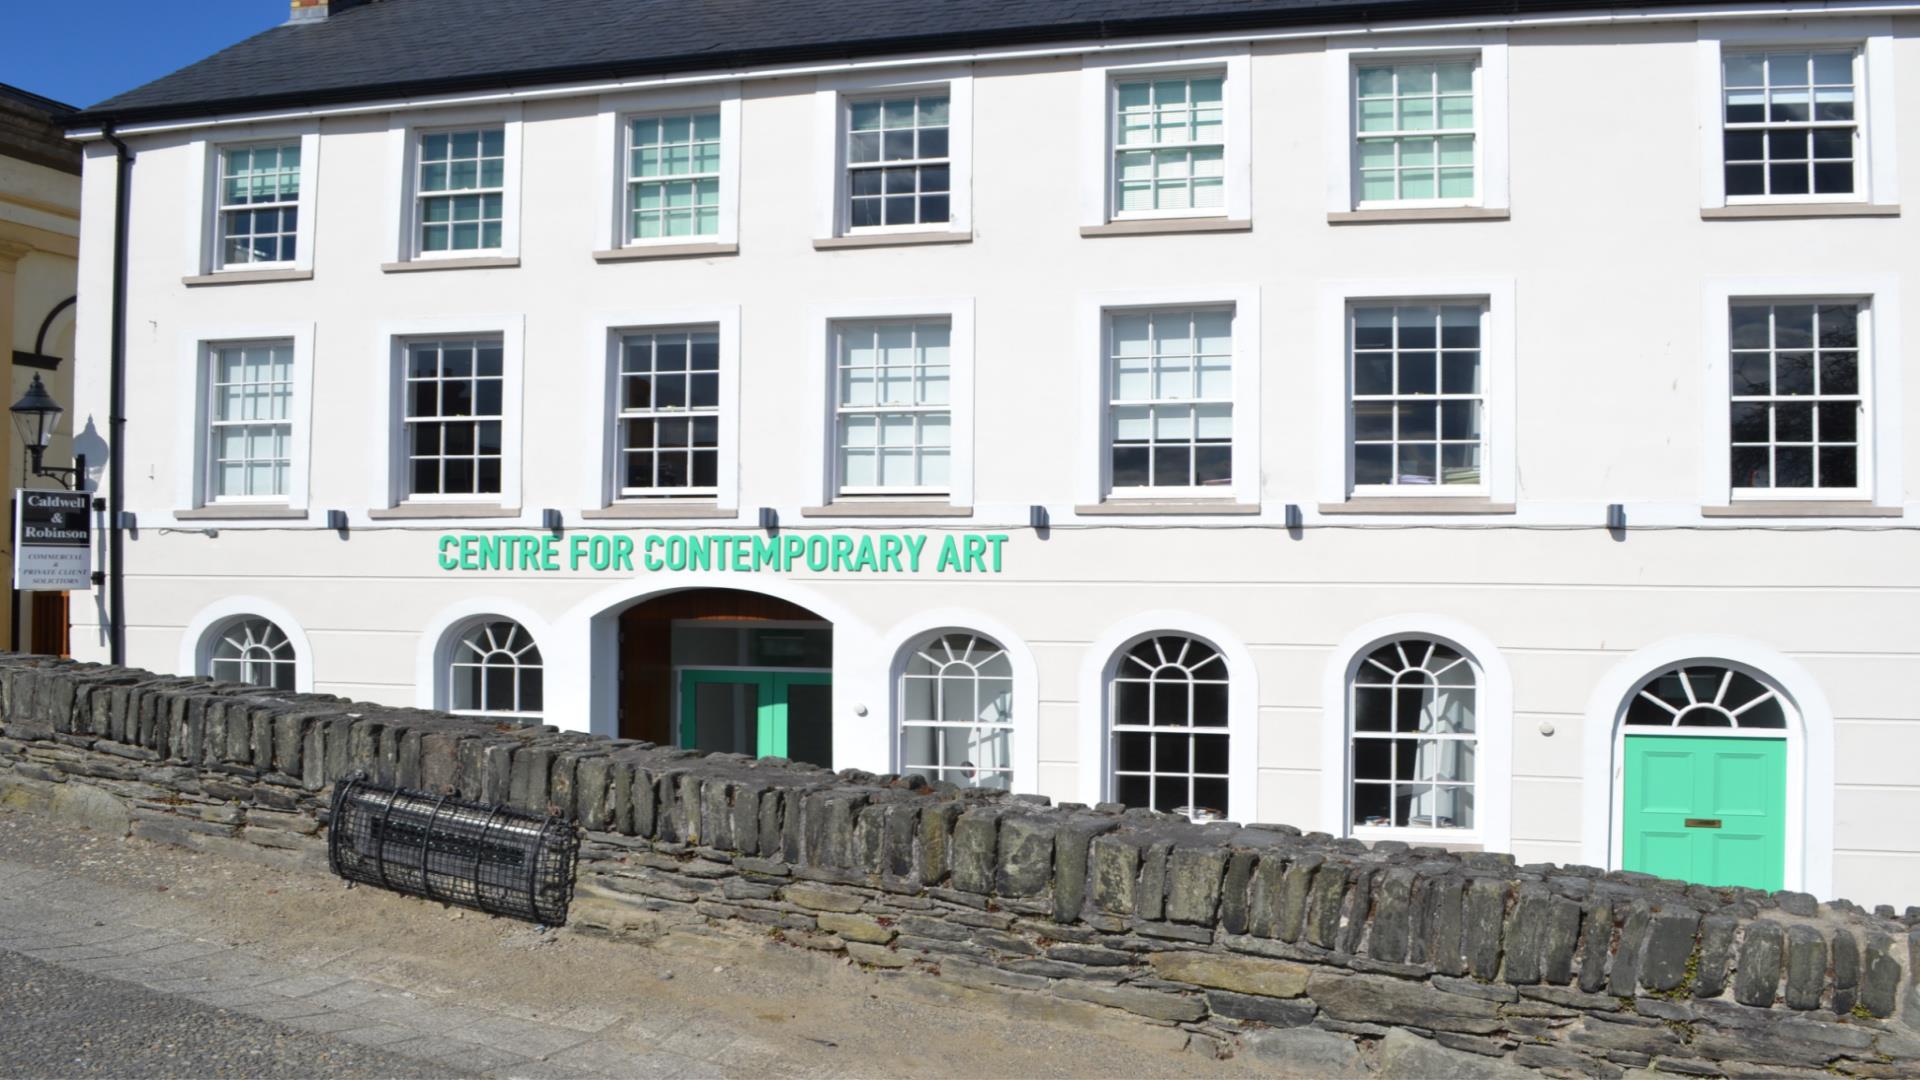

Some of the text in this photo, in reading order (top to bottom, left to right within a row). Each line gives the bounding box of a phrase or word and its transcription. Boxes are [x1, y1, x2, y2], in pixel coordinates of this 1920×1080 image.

[28, 495, 85, 509] Caldwell
[51, 512, 62, 523] &
[25, 526, 87, 539] Robinson
[438, 534, 1009, 573] CENTRE FOR CONTEMPORARY ART
